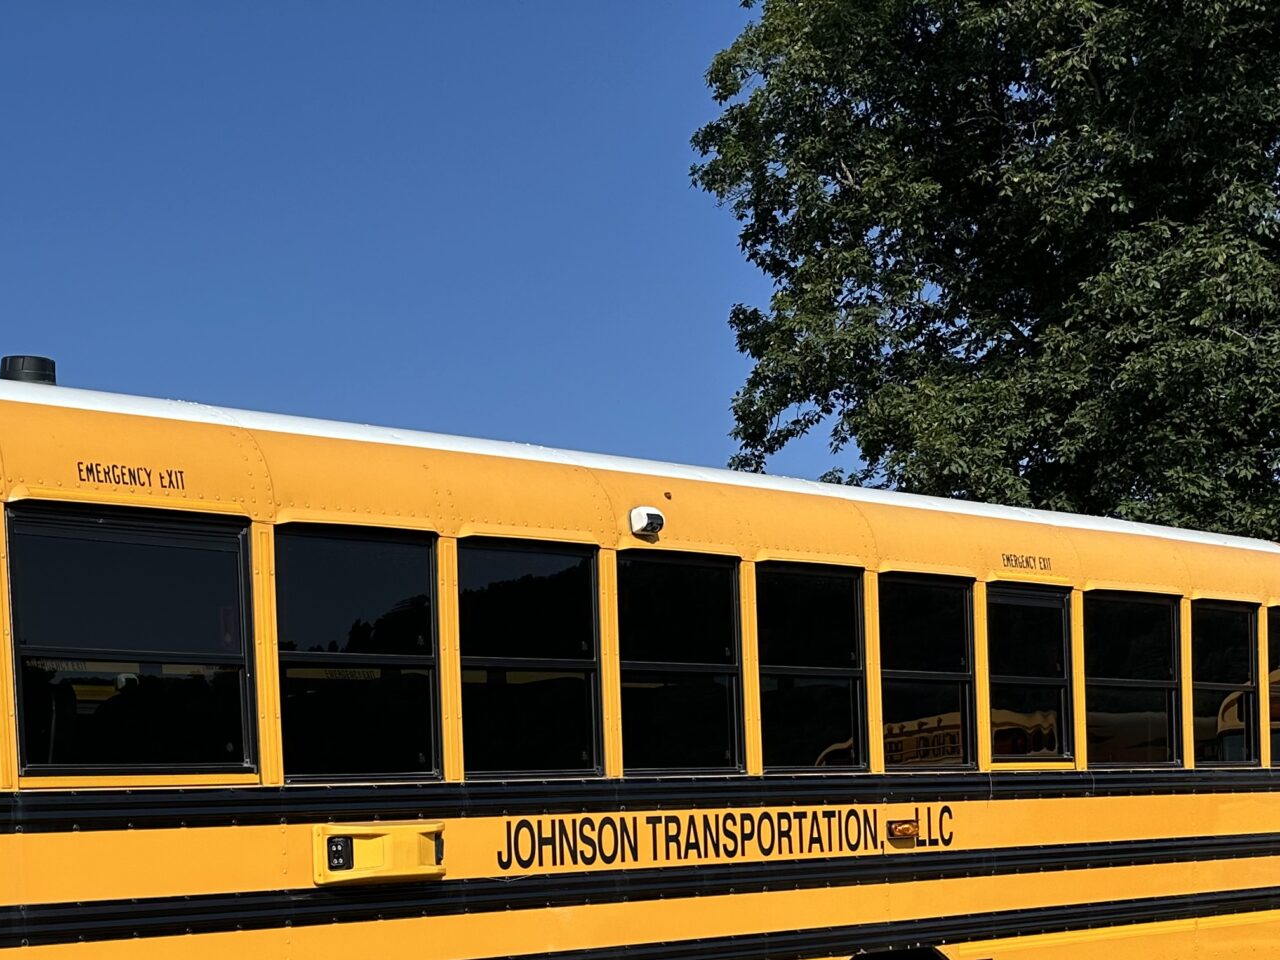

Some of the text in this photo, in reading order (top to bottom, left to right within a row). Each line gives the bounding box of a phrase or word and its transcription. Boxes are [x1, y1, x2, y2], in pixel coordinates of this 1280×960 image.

[77, 461, 185, 490] EMERGENCY EXIT
[1001, 553, 1052, 571] EMERGENCY EXIT
[497, 805, 954, 870] JOHNSON TRANSPORTATION, LLC
